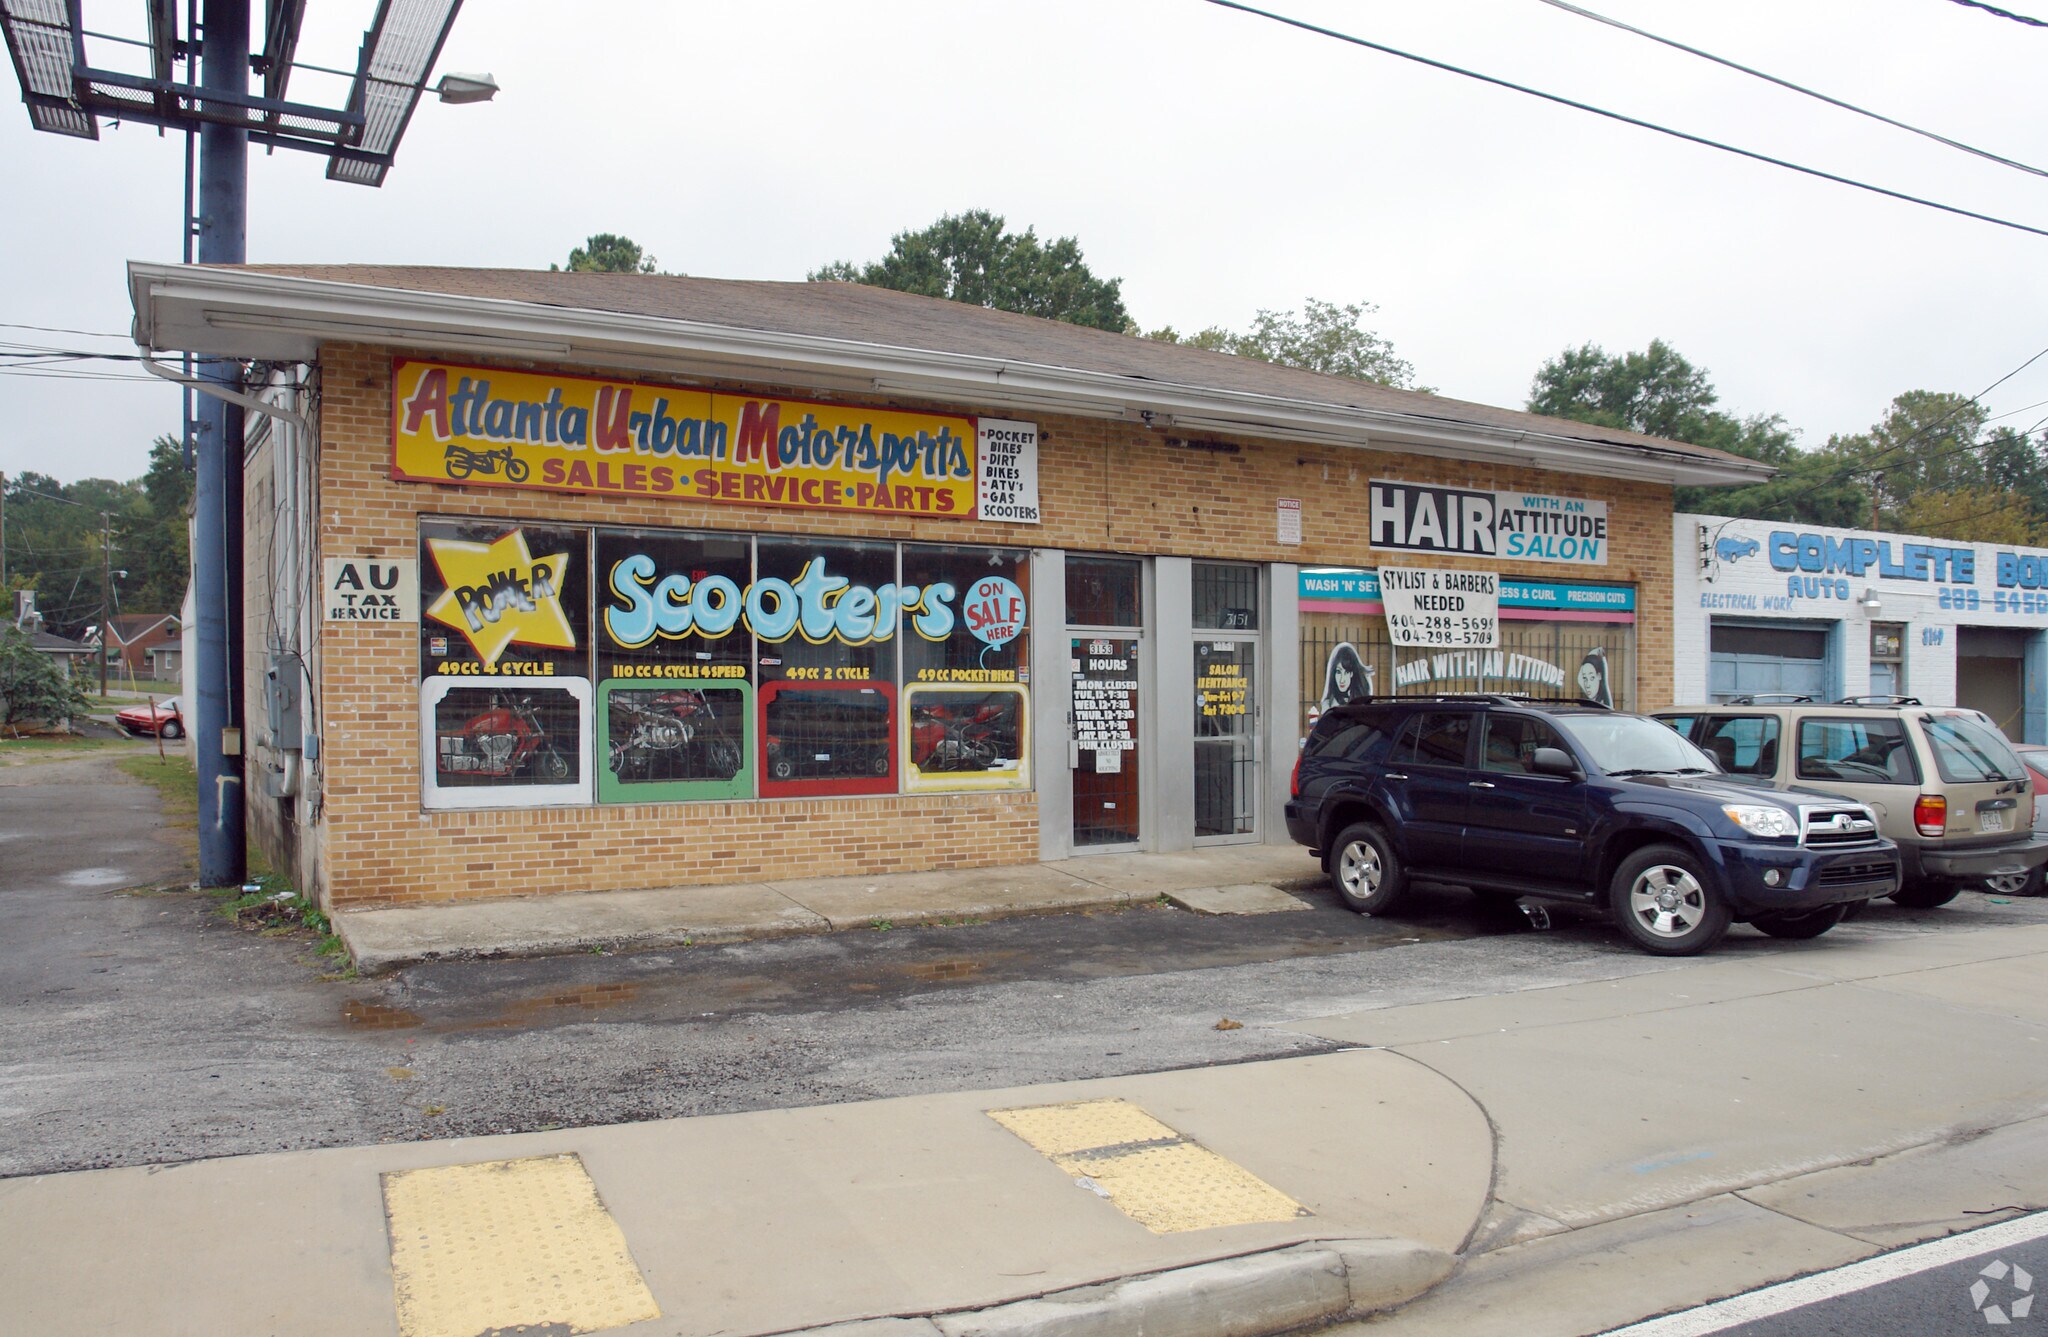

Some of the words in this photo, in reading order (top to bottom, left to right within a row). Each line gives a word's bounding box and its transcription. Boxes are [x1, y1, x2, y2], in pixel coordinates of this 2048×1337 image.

[402, 368, 588, 448] Atlanta
[594, 385, 728, 461] Urban
[733, 401, 972, 484] Motorsports
[987, 429, 1034, 444] POCKET
[990, 442, 1022, 454] BIKES
[990, 453, 1016, 466] DIRT
[986, 466, 1019, 479] BIKES
[542, 458, 674, 492] SALES
[693, 467, 842, 505] SERVICE
[856, 482, 955, 512] PARTS
[991, 479, 1023, 491] ATV's
[990, 492, 1015, 504] GAS
[1522, 496, 1560, 510] WITH
[1564, 501, 1584, 512] AN
[984, 505, 1037, 519] SCOOTERS
[1371, 487, 1496, 552] HAIR
[1499, 508, 1606, 539] ATTITUDE
[1507, 533, 1599, 560] SALON
[1769, 531, 1975, 584] COMPLETE
[334, 563, 399, 590] AU
[1383, 570, 1426, 590] STYLIST
[1432, 574, 1440, 589] &
[1445, 574, 1494, 595] BARBERS
[979, 582, 1004, 597] ON
[1305, 579, 1340, 592] WASH
[1788, 575, 1849, 600] AUTO
[341, 594, 396, 606] TAX
[454, 563, 556, 633] POWER
[1498, 587, 1520, 598] RESS
[1522, 588, 1529, 599] &
[1531, 589, 1556, 600] CURL
[1567, 590, 1606, 602] PRECISION
[1607, 592, 1626, 603] CUTS
[1938, 587, 1979, 610] 289
[606, 555, 956, 648] Scooters
[1414, 595, 1465, 612] NEEDED
[1700, 592, 1757, 610] ELECTRICAL
[1764, 595, 1794, 611] WORK
[331, 608, 400, 619] SERVICE
[967, 597, 1021, 631] SALE
[1226, 613, 1248, 626] 3151
[986, 625, 1014, 641] HERE
[1090, 645, 1112, 654] 3153
[438, 661, 479, 675] 49CC
[484, 661, 498, 674] 4
[502, 662, 554, 675] CYCLE
[613, 665, 633, 677] 110
[652, 665, 663, 678] 4
[665, 665, 700, 678] CYCLE
[701, 665, 712, 678] 4
[712, 665, 746, 678] SPEED
[1089, 658, 1127, 671] HOURS
[1208, 664, 1240, 675] SALON
[1396, 658, 1430, 687] HAIR
[1432, 650, 1478, 680] WITH
[1482, 650, 1504, 679] AN
[1507, 652, 1566, 687] ATTITUDE
[786, 667, 819, 680] 49CC
[824, 667, 832, 680] 2
[836, 667, 870, 680] CYCLE
[951, 669, 989, 682] POCKET
[1105, 681, 1137, 690] CLOSED
[1100, 740, 1134, 750] CLOSED
